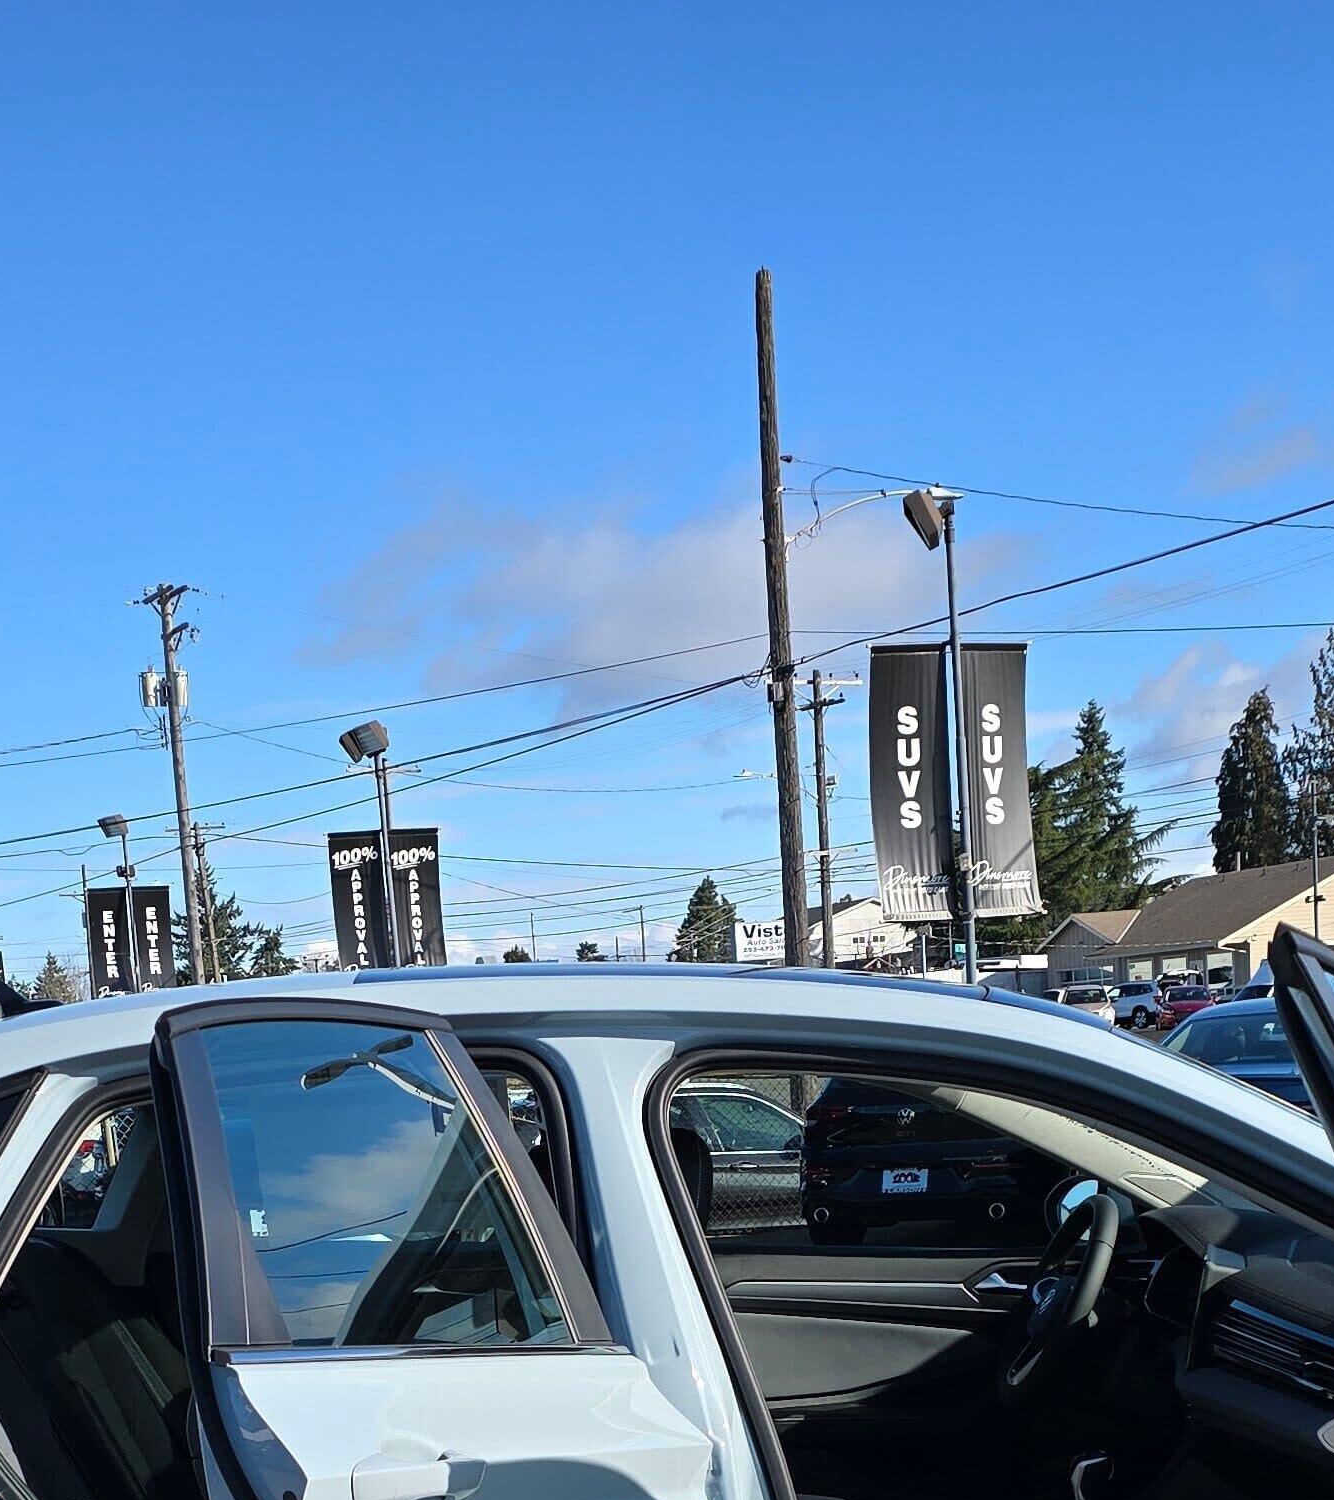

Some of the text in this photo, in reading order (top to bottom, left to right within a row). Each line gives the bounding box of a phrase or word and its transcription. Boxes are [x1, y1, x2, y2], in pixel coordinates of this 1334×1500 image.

[897, 705, 923, 829] SUVS
[981, 703, 1006, 825] SUVS
[331, 846, 378, 868] 100%
[390, 846, 436, 868] 100%
[102, 910, 119, 978] ENTER
[145, 906, 162, 975] ENTER
[351, 869, 369, 965] APPROVAL
[409, 869, 425, 965] APPROVAL
[743, 924, 783, 938] Vist
